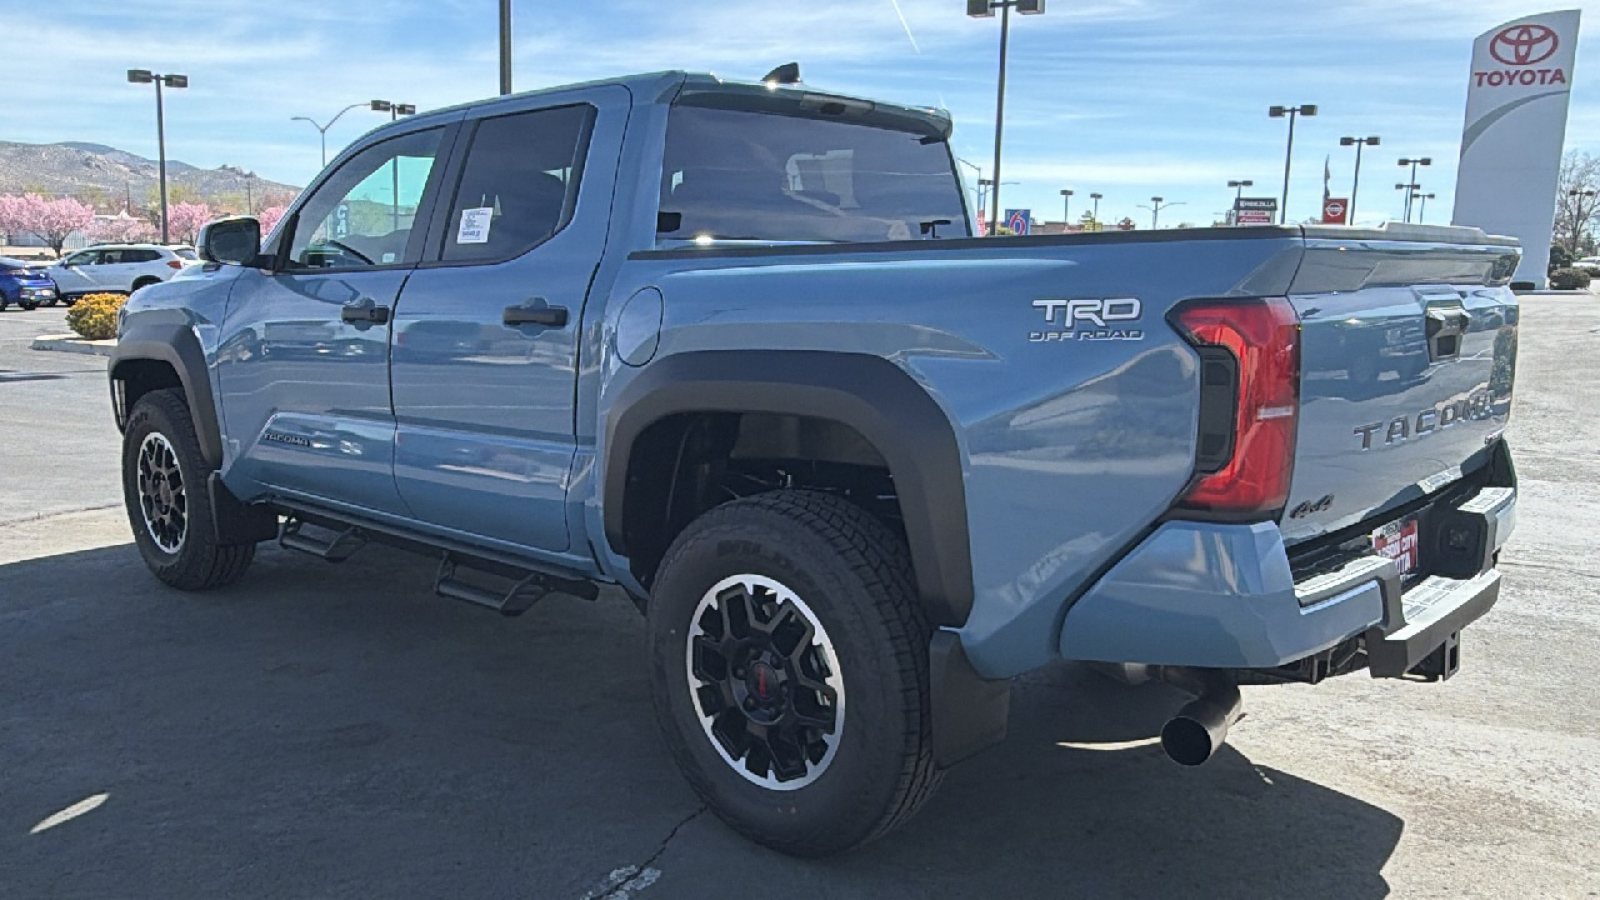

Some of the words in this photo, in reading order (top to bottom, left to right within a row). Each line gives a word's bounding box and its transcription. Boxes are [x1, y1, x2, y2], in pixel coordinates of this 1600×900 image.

[1474, 69, 1566, 87] TOYOTA
[1032, 298, 1141, 328] TRD
[1028, 330, 1075, 342] OFF
[1077, 329, 1145, 341] ROAD
[1353, 389, 1496, 451] TACOMA
[264, 433, 310, 446] TACOMA
[1394, 552, 1411, 574] OTA
